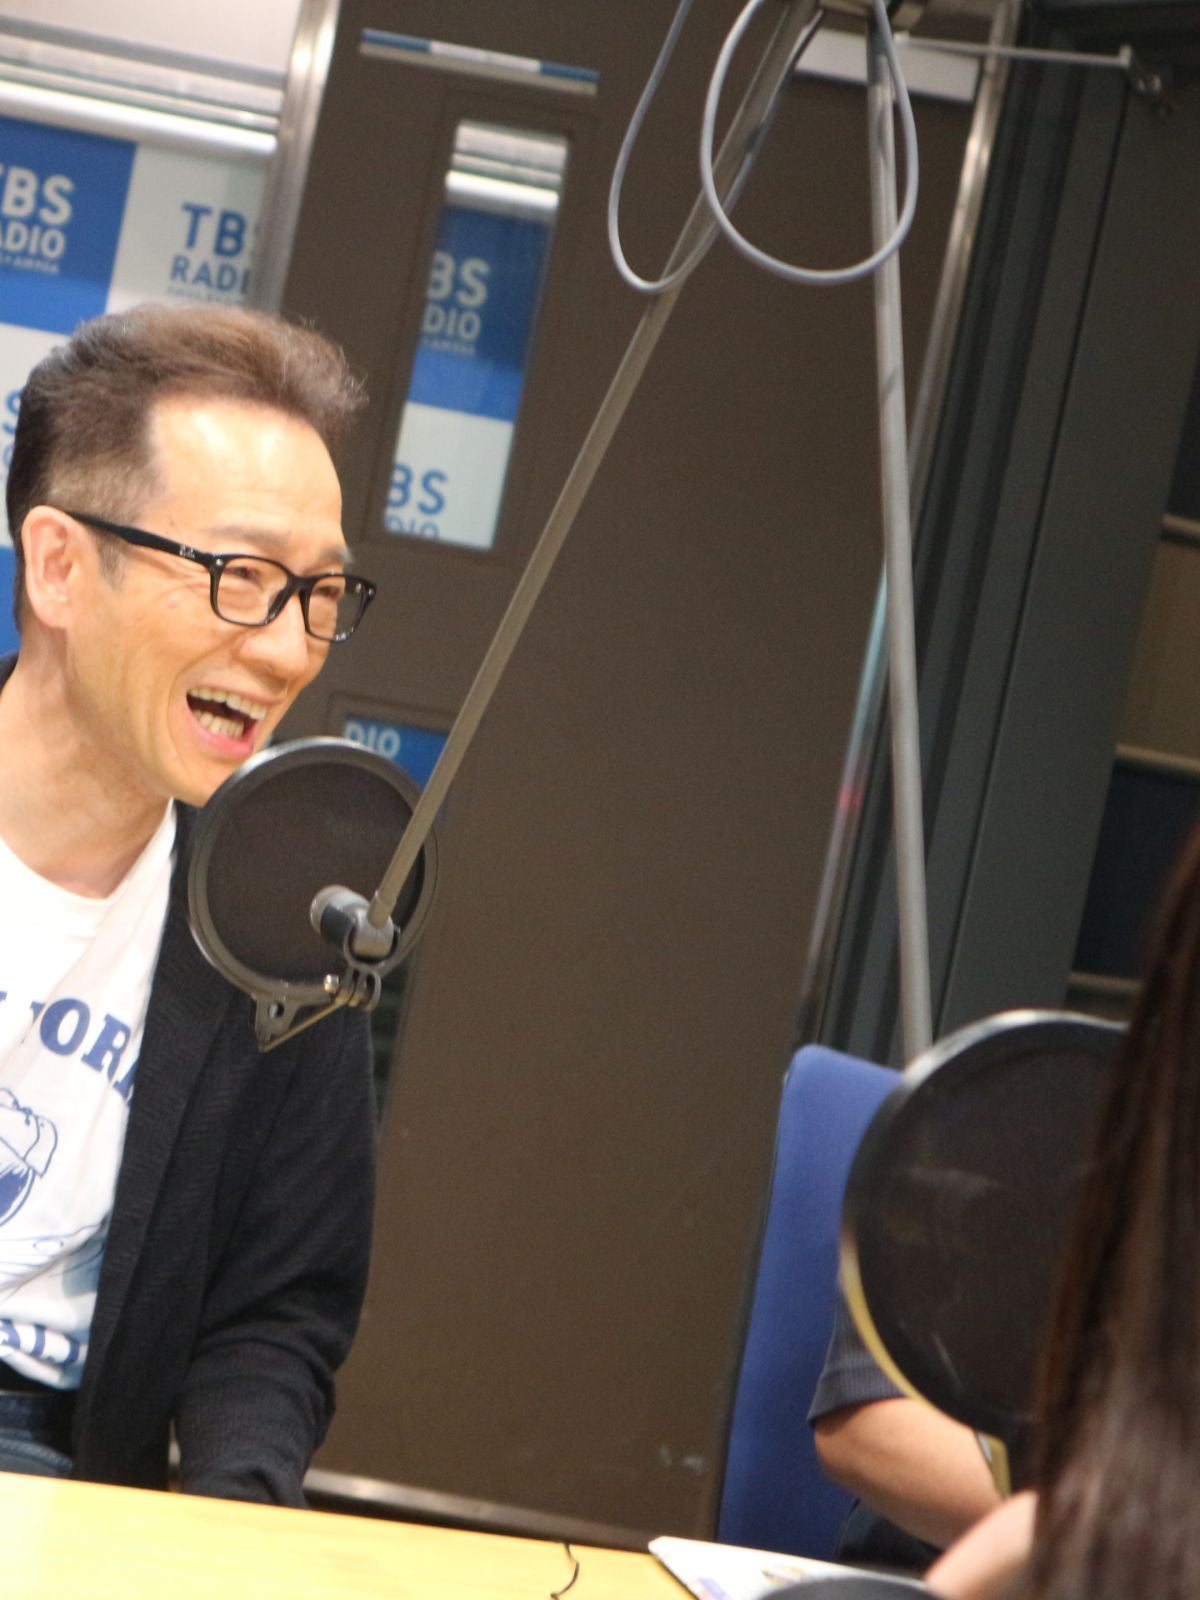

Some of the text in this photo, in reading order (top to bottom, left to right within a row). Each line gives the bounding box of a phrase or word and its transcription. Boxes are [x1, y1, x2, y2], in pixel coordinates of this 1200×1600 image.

[182, 203, 259, 258] TB
[170, 254, 250, 294] RADI
[427, 250, 491, 307] BS
[422, 304, 482, 342] DIO
[388, 463, 448, 515] BS
[385, 515, 440, 539] DIO
[345, 721, 401, 759] DIO
[30, 997, 138, 1099] OR
